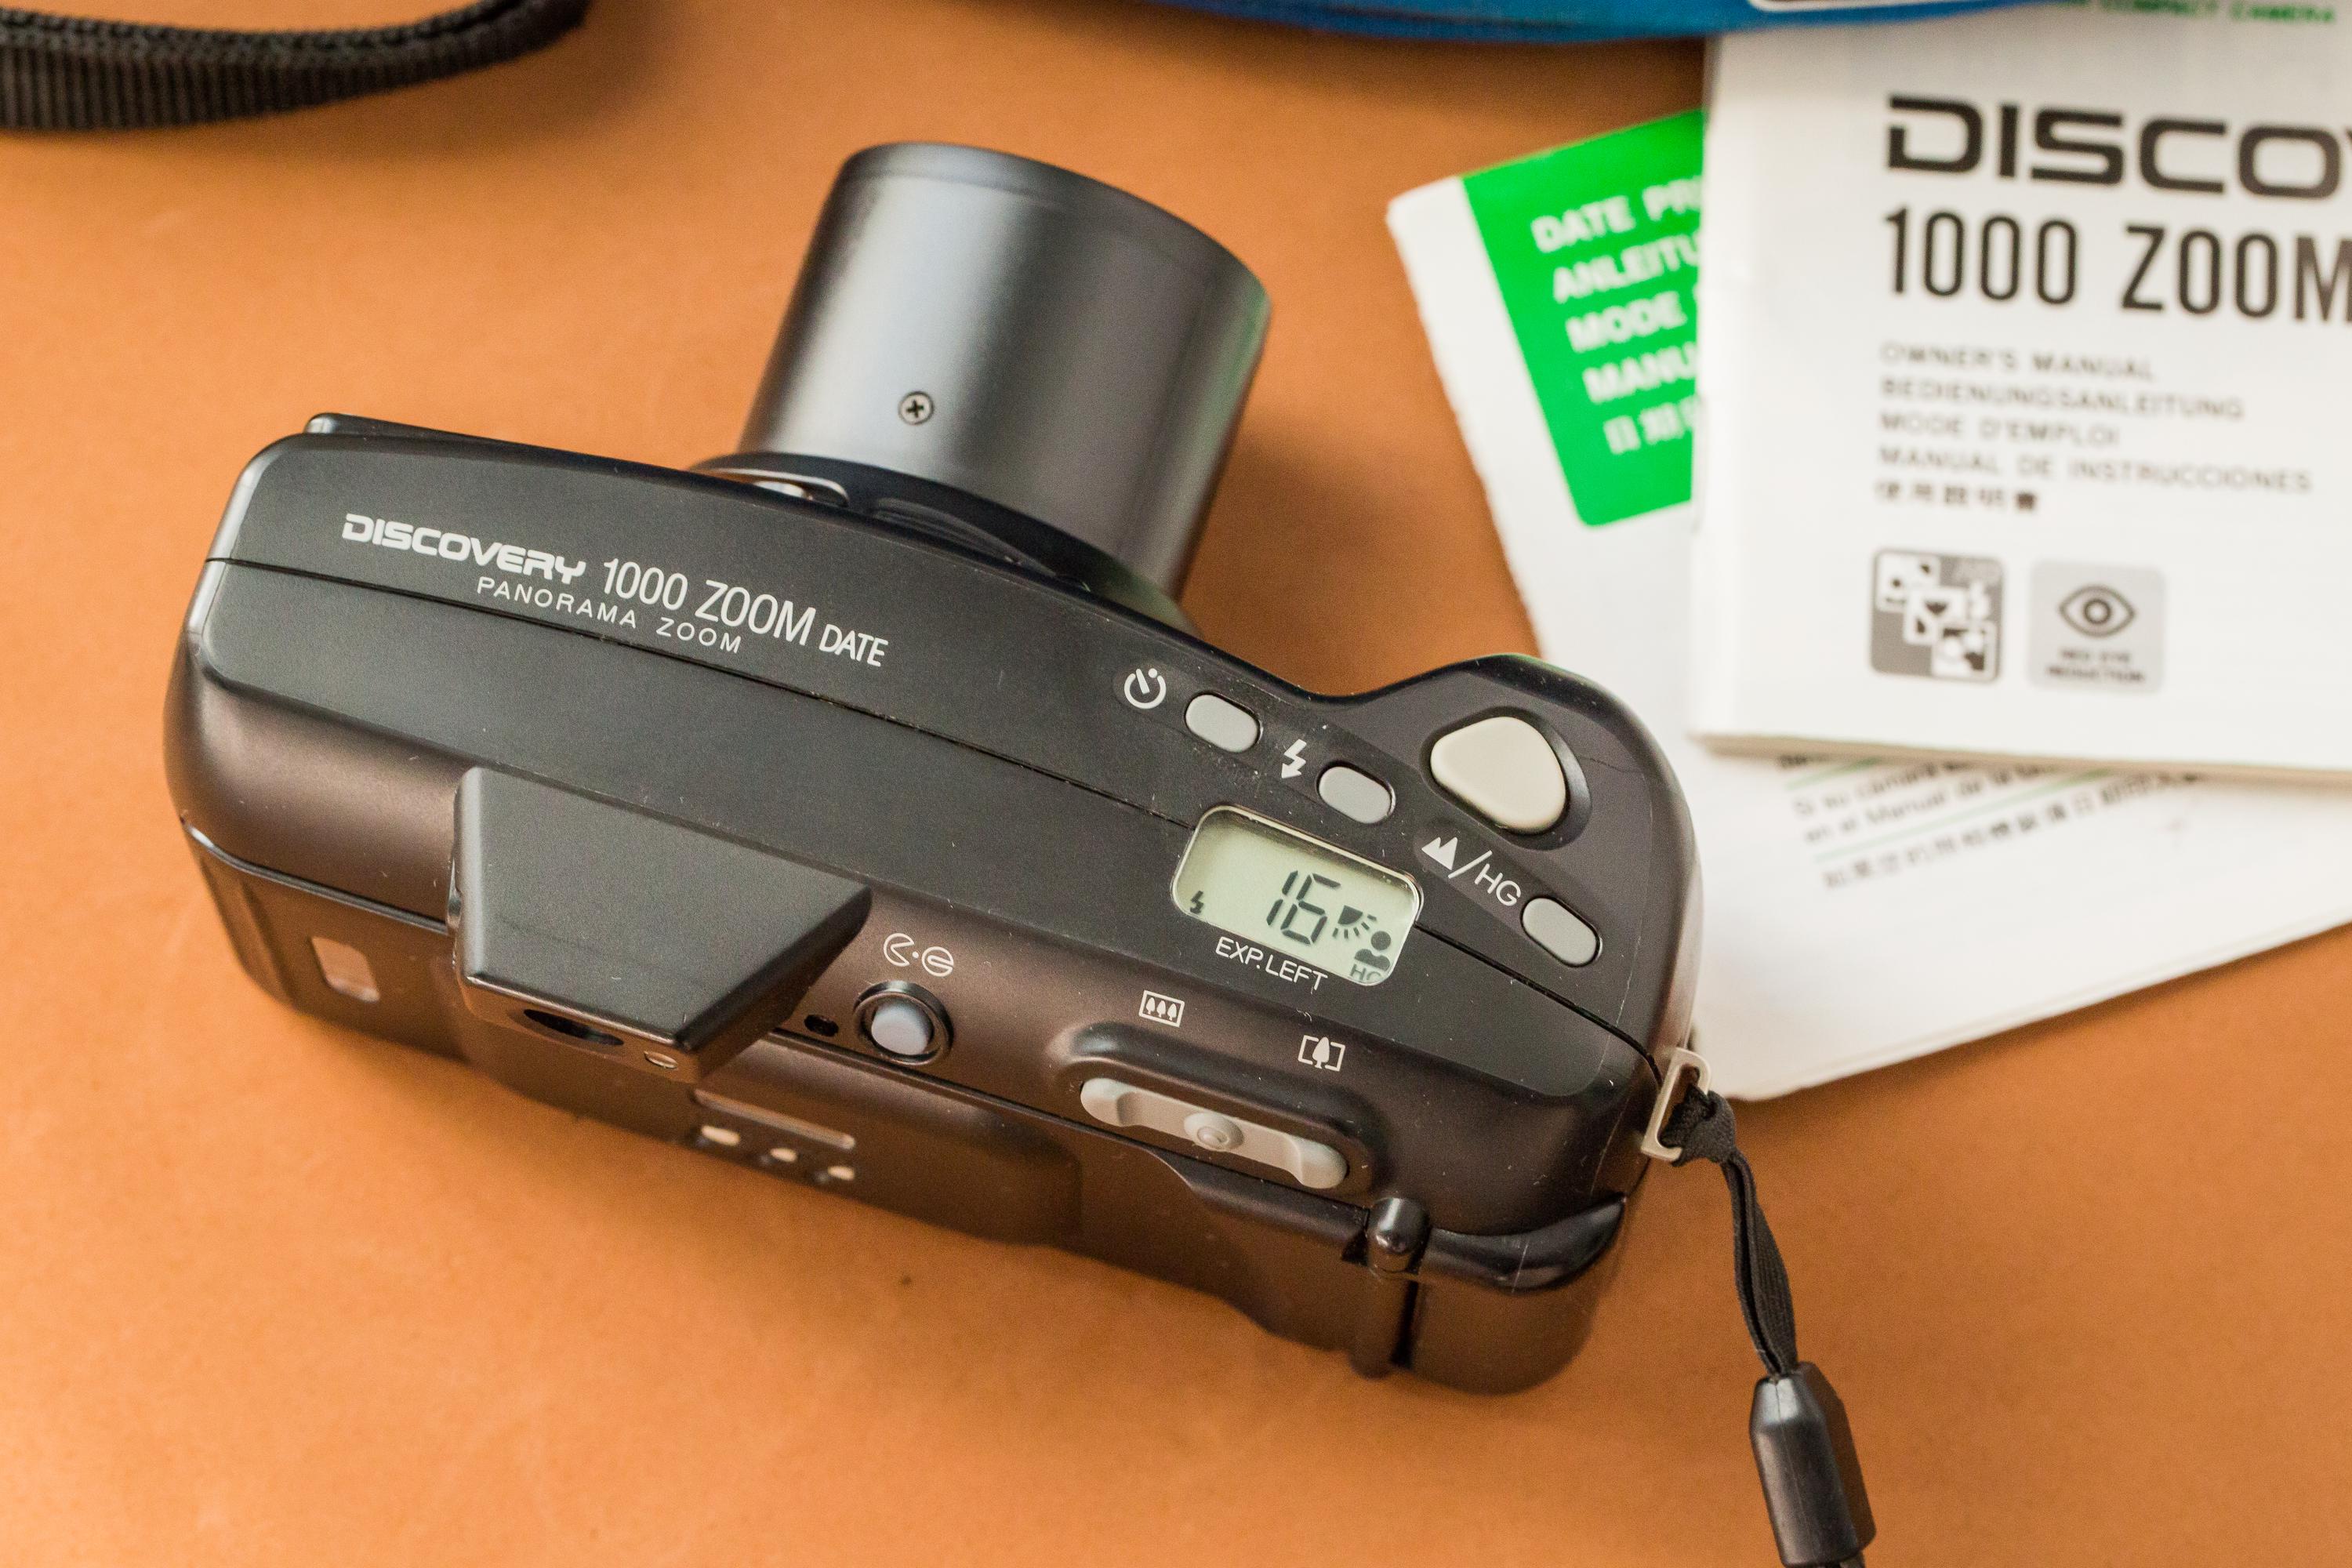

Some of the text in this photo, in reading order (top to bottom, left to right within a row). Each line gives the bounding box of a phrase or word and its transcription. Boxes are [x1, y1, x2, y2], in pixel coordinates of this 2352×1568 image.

[1888, 96, 2352, 198] DISCO
[1530, 194, 1636, 253] DATE
[1885, 207, 2352, 322] 1000 ZOOM
[1565, 290, 1687, 354] MODE
[1880, 340, 2154, 381] OWNER'S MANUAL
[1880, 376, 2245, 419] BEDIENUNGSANLEITUNG
[1880, 412, 2121, 448] MODE D'EMPLOI
[1879, 446, 2313, 493] MANUAL DE INSTRUCCIONES
[342, 513, 889, 666] DISCOVERY 1000 ZOOM DATE
[477, 576, 742, 654] PANORAMA ZOOM
[1266, 869, 1341, 946] 16
